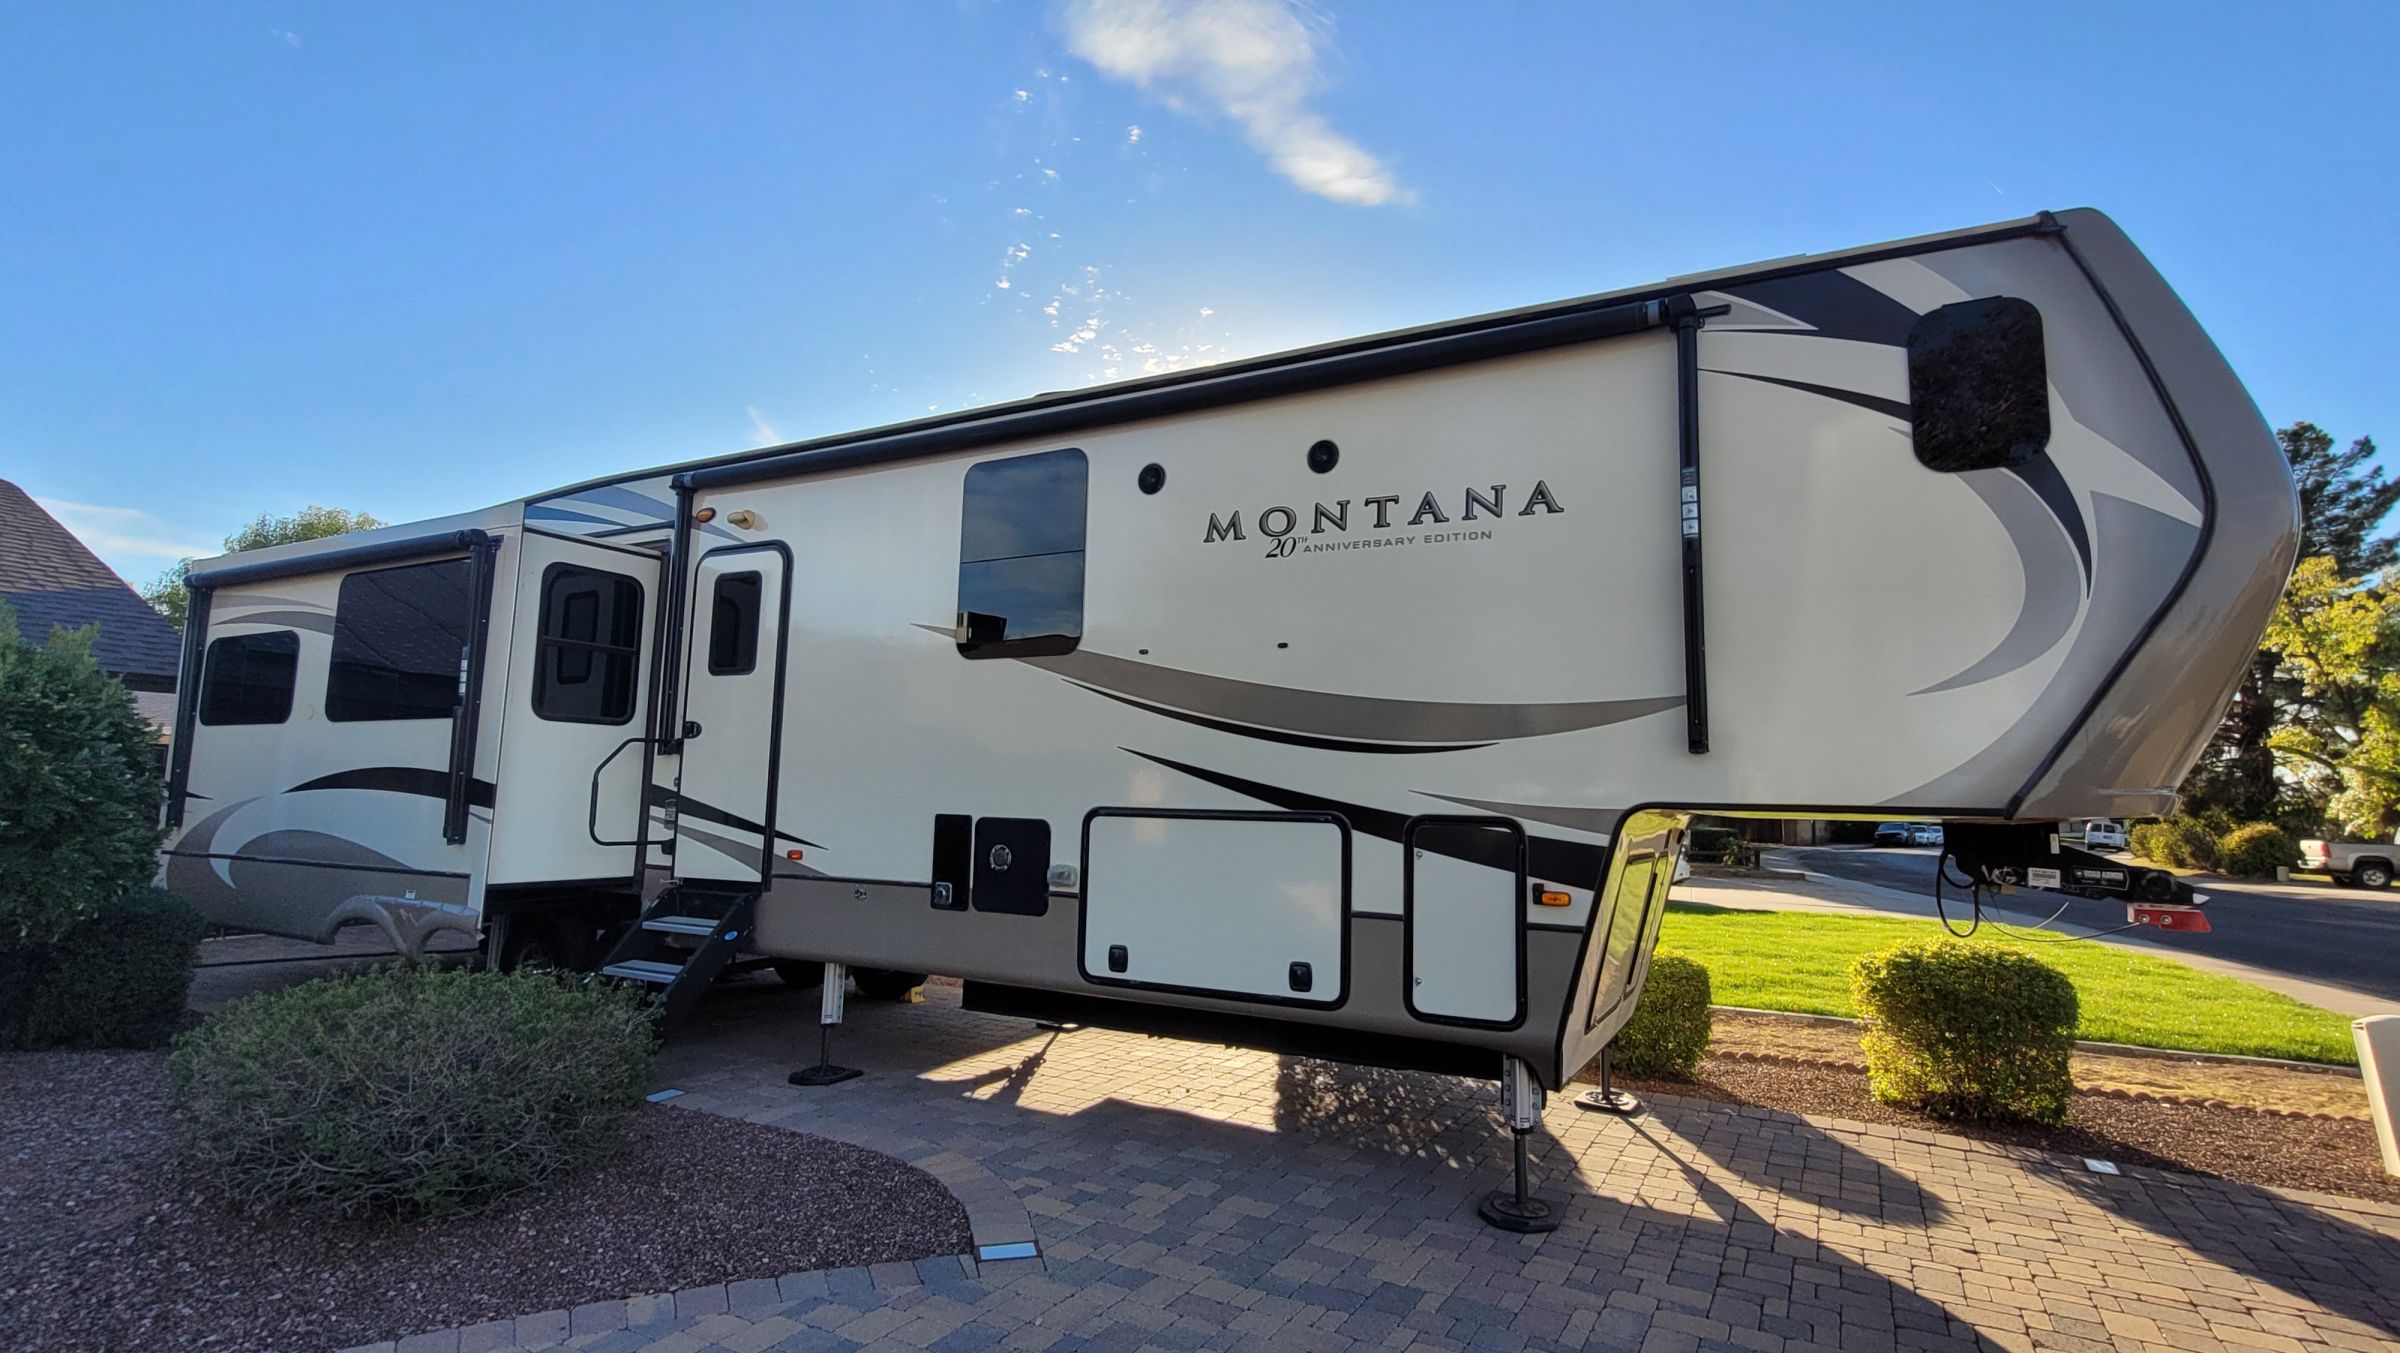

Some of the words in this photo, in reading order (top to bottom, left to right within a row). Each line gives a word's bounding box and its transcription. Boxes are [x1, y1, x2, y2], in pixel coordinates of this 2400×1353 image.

[1203, 480, 1565, 543] MONTANA
[1264, 536, 1308, 559] 20TH
[1303, 536, 1416, 553] ANNIVERSARY
[1423, 530, 1493, 544] EDITION
